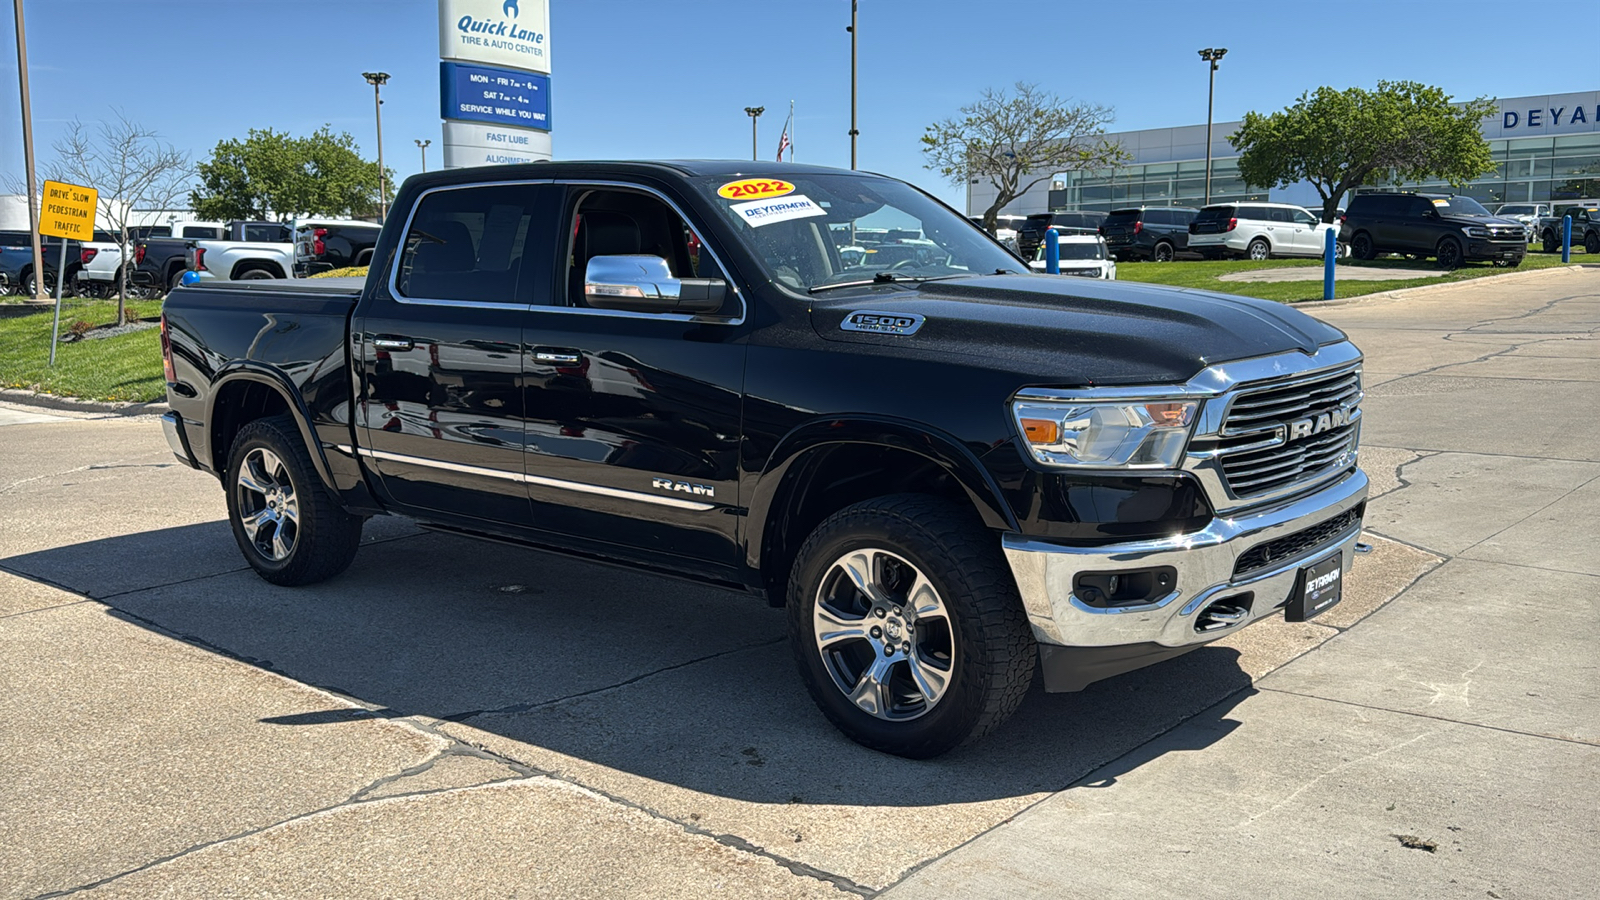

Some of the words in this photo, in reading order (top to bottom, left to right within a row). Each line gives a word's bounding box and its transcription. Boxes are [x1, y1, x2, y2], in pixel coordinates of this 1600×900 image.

[458, 15, 508, 36] Quick
[509, 24, 544, 44] Lane
[461, 35, 482, 46] TIRE
[483, 38, 490, 47] &
[491, 40, 514, 51] AUTO
[515, 43, 543, 57] CENTER
[470, 74, 489, 84] MON
[497, 77, 509, 86] FRI
[483, 91, 497, 99] SAT
[460, 103, 493, 114] SERVICE
[495, 107, 517, 117] WHILE
[518, 110, 532, 119] YOU
[533, 112, 546, 121] WAIT
[1503, 104, 1600, 129] DEYA
[486, 132, 507, 142] FAST
[508, 135, 529, 145] LUBE
[50, 189, 69, 200] DRIVE
[73, 193, 89, 203] SLOW
[728, 180, 789, 198] 2022
[48, 204, 87, 218] PEDESTRIAN
[744, 200, 812, 217] DEYARMAN
[54, 221, 80, 233] TRAFFIC
[856, 315, 912, 328] 1500
[1290, 404, 1350, 441] RAM
[652, 477, 715, 497] RAM
